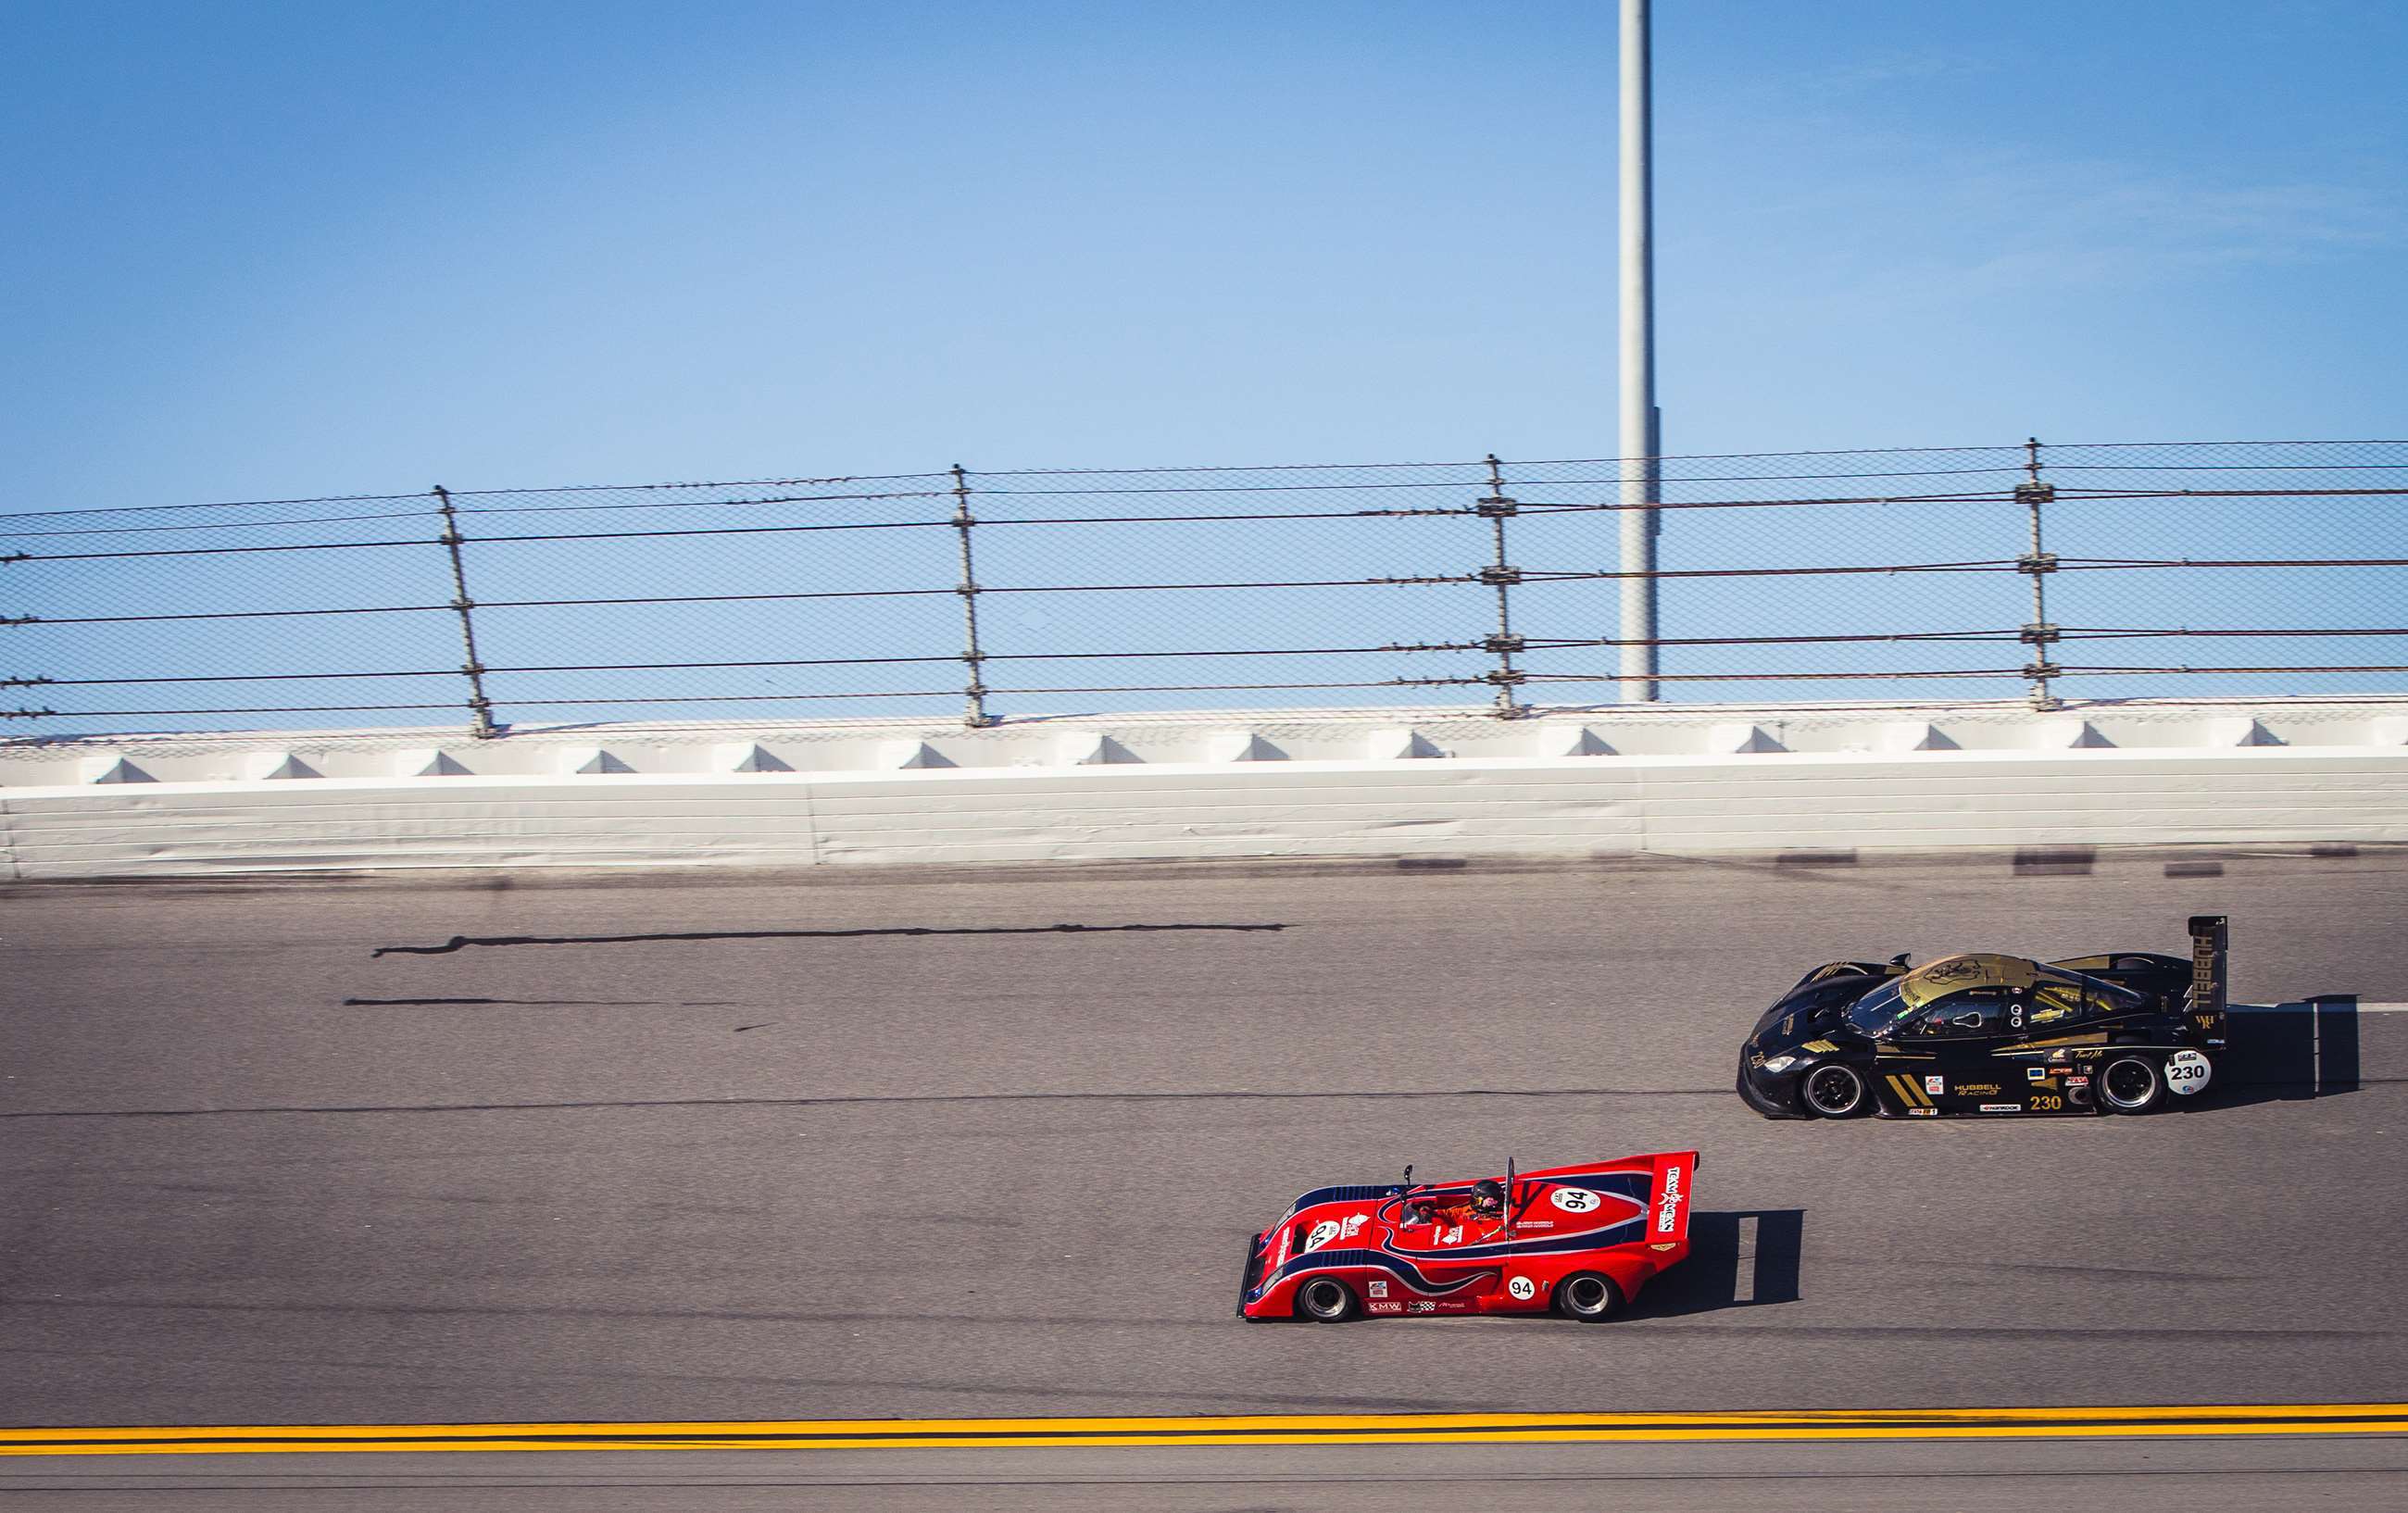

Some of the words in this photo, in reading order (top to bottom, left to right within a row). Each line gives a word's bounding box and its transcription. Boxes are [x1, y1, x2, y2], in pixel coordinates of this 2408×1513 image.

[2193, 936, 2213, 1008] HUBBELL
[2171, 1065, 2205, 1081] 230
[2030, 1095, 2063, 1110] 230
[1565, 1192, 1588, 1209] 94
[1511, 1282, 1532, 1295] 94
[1370, 1302, 1401, 1311] KMW
